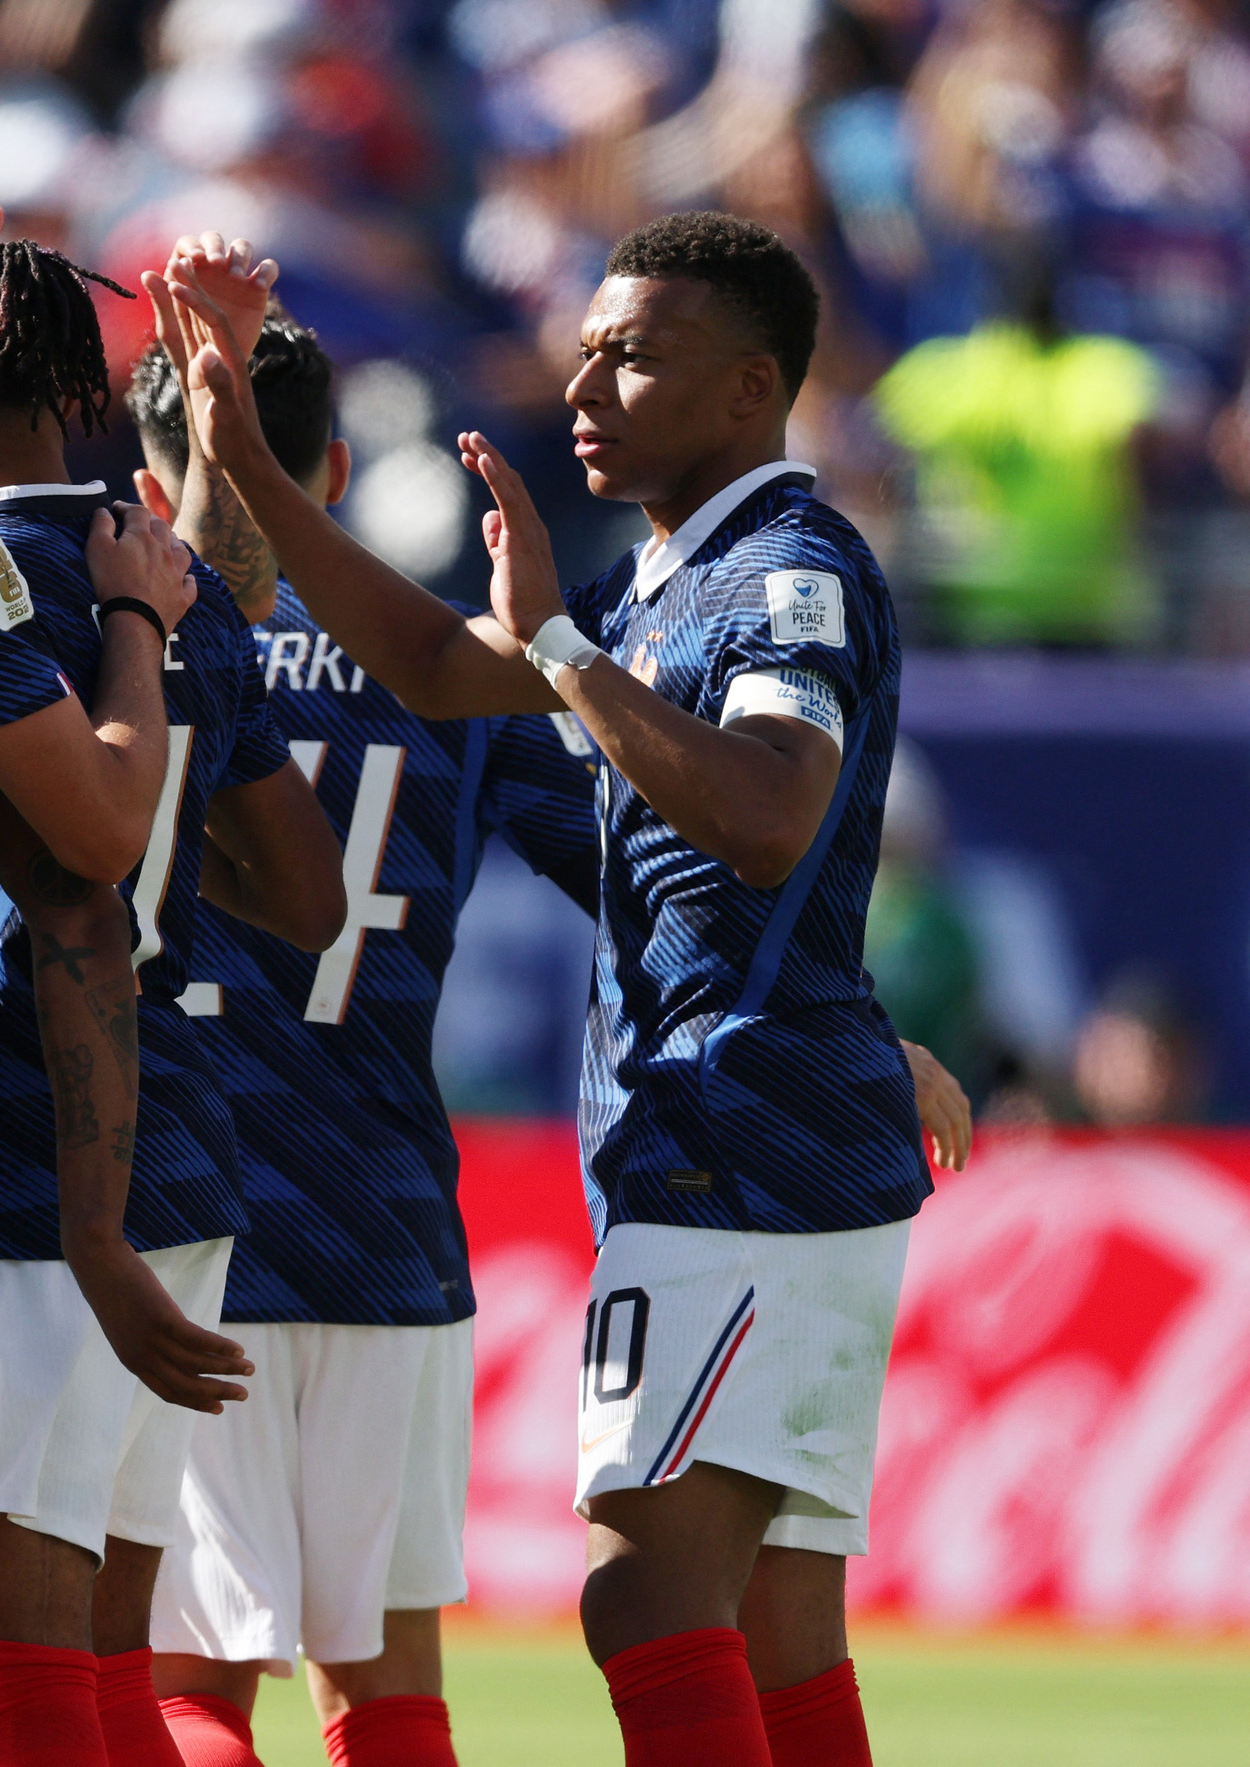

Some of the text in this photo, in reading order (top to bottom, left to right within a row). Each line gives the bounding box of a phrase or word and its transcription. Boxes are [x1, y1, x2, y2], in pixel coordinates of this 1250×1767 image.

[9, 586, 21, 597] FIFA
[7, 604, 29, 621] 202
[789, 599, 827, 612] Unite For
[792, 612, 826, 627] PEACE
[774, 687, 806, 702] the
[801, 706, 831, 730] FIFA
[581, 1287, 651, 1412] 10
